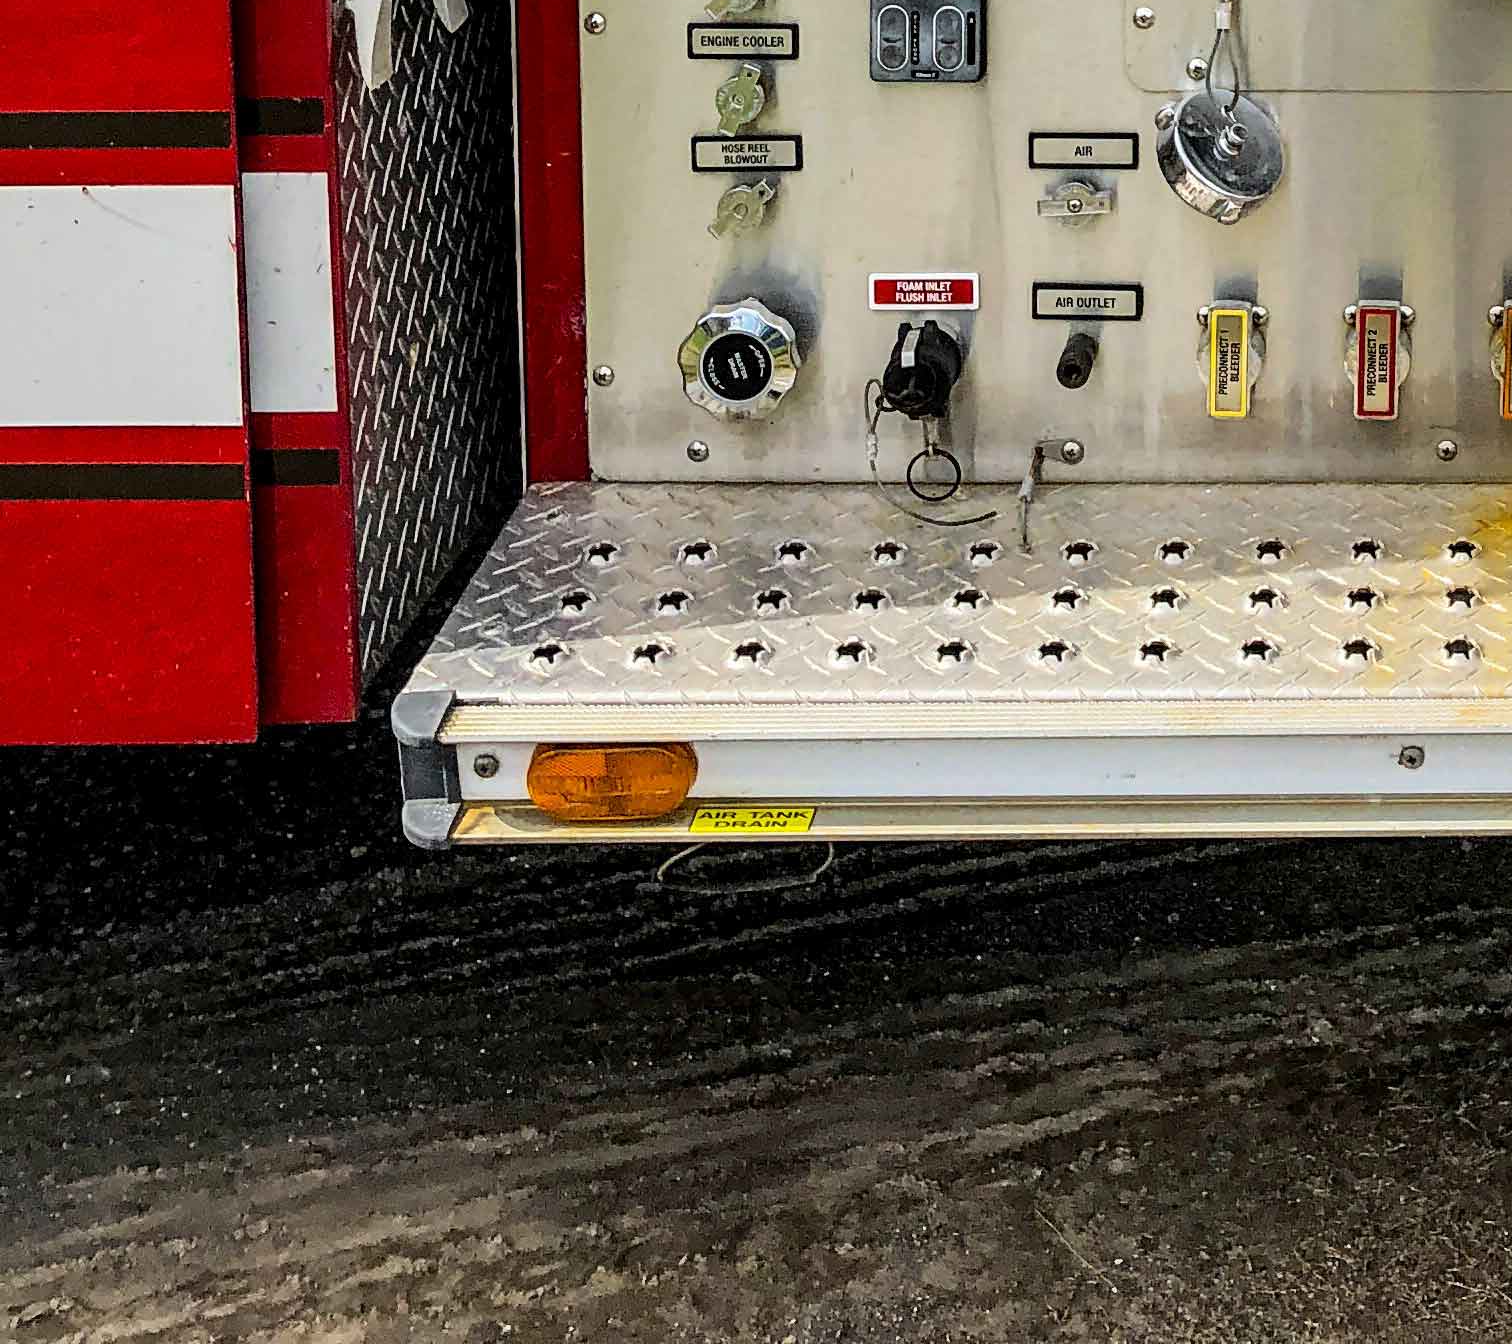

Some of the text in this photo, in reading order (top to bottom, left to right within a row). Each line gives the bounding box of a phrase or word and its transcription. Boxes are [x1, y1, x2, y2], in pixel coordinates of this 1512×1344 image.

[700, 36, 785, 48] ENGINE COOLER
[721, 144, 771, 154] HOSE REEL
[1074, 145, 1093, 158] AIR
[724, 155, 768, 164] BLOWOUT
[897, 280, 951, 292] FOAM INLET
[895, 291, 952, 303] FLUSH INLET
[1055, 296, 1116, 309] AIR OUTLET
[1218, 338, 1229, 395] PRECONNECT
[1230, 342, 1241, 383] BLEEDER
[1367, 338, 1377, 396] PRECONNECT
[1378, 343, 1389, 383] BLEEDER
[698, 811, 808, 820] AIR TANK
[714, 820, 788, 828] DRAIN
